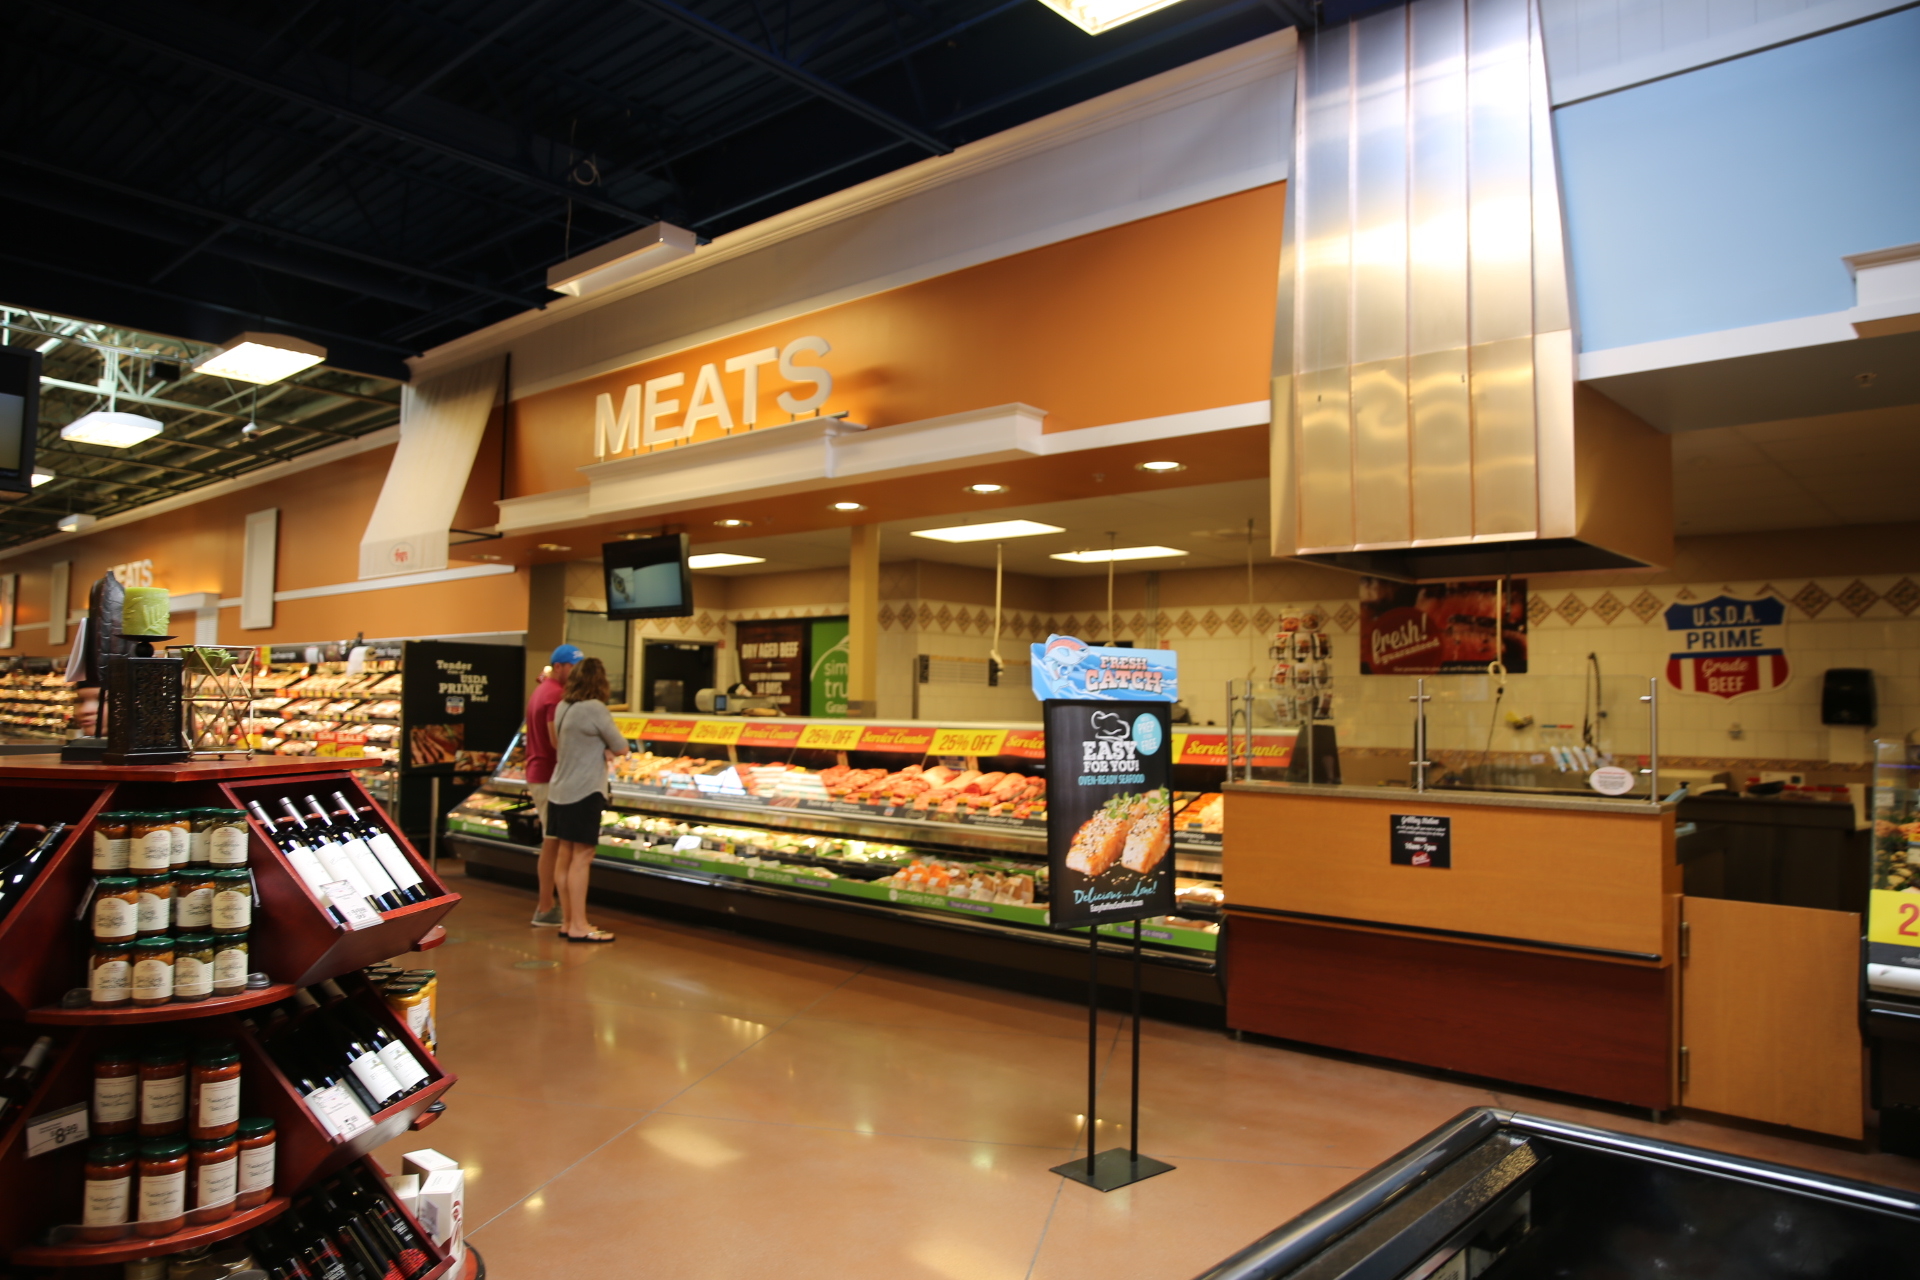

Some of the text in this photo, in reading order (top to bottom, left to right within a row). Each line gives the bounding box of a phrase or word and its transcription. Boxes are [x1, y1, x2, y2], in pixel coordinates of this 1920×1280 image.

[594, 335, 833, 458] MEATS
[107, 559, 154, 588] EATS
[1692, 604, 1760, 626] U.S.D.A.
[1372, 612, 1428, 665] fresh!
[1686, 628, 1763, 650] PRIME
[742, 641, 799, 659] DRY AGED BEEF
[1380, 636, 1441, 665] guaranteed
[436, 660, 472, 671] Tender
[1100, 656, 1148, 670] FRESH
[1702, 658, 1749, 678] Grade
[460, 674, 488, 685] USDA
[1085, 669, 1163, 694] CATCH
[1708, 675, 1745, 692] BEEF
[438, 682, 484, 695] PRIME
[696, 725, 736, 740] 25% OFF
[742, 727, 769, 739] Service
[805, 729, 855, 745] 25% OFF
[861, 731, 931, 744] Service Counter
[938, 735, 998, 751] 25% OFF
[1006, 736, 1044, 750] Service
[1082, 740, 1138, 761] EASY
[1141, 738, 1159, 752] FREE
[1083, 760, 1140, 773] FOR YOU!
[1118, 774, 1146, 784] SEAFOOD
